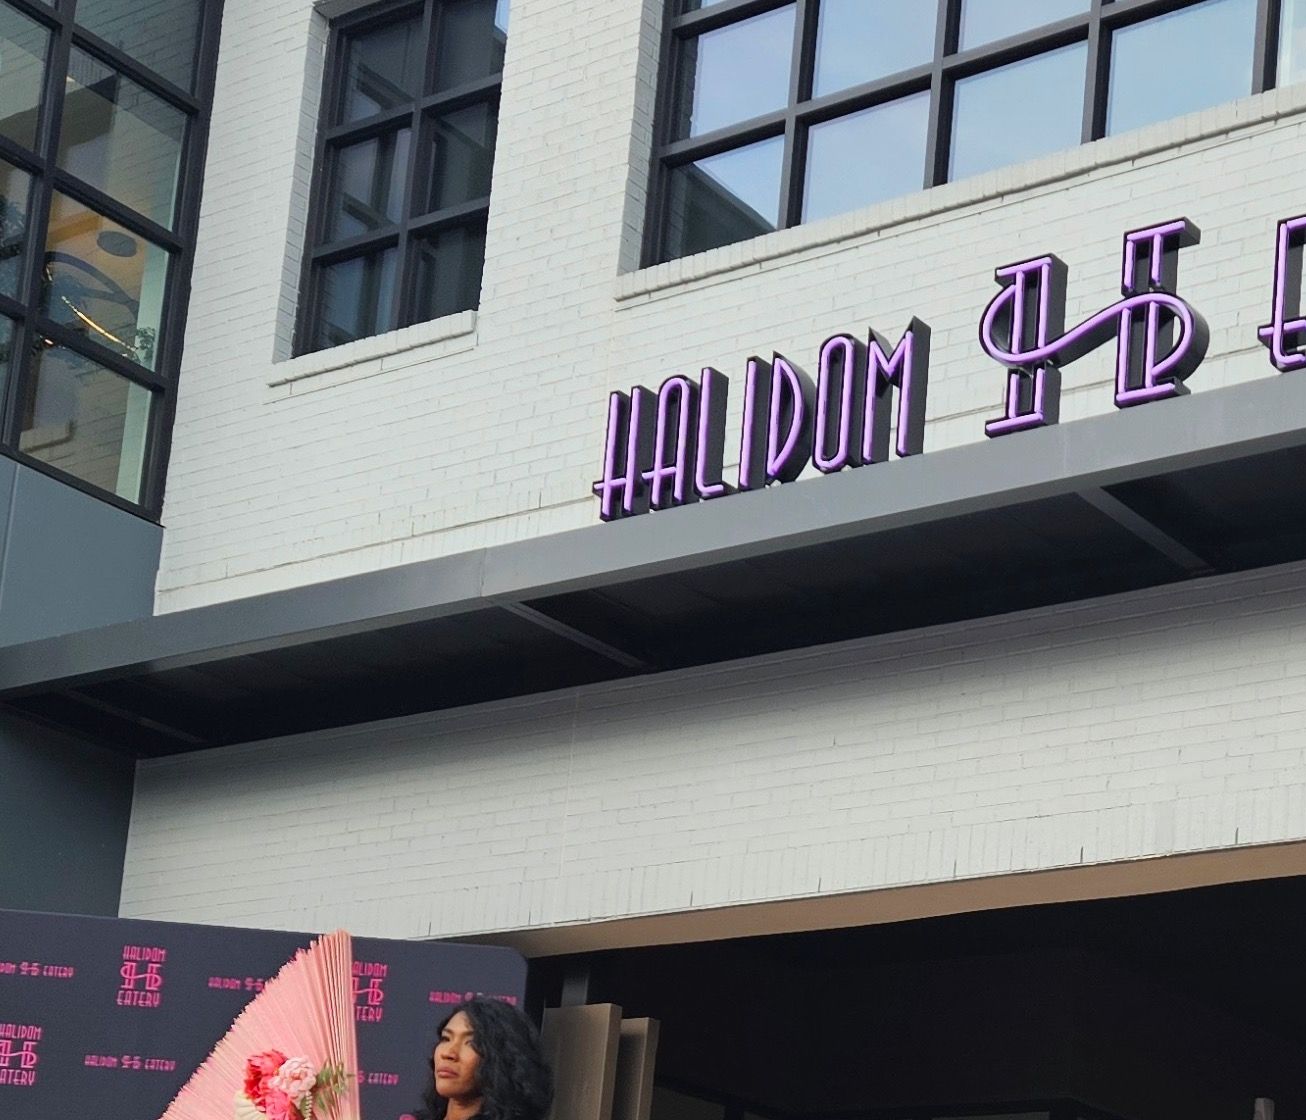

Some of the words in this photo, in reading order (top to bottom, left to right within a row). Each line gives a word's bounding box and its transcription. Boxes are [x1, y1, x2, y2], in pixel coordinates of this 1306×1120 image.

[593, 316, 931, 521] HALIDOM
[122, 945, 166, 961] HALIDOM
[43, 965, 74, 978] EATERY
[352, 960, 387, 977] ALIDOM
[116, 990, 161, 1008] EATERY
[356, 1005, 382, 1022] TERY
[144, 1058, 177, 1072] EATERY
[0, 1068, 36, 1086] ATERY
